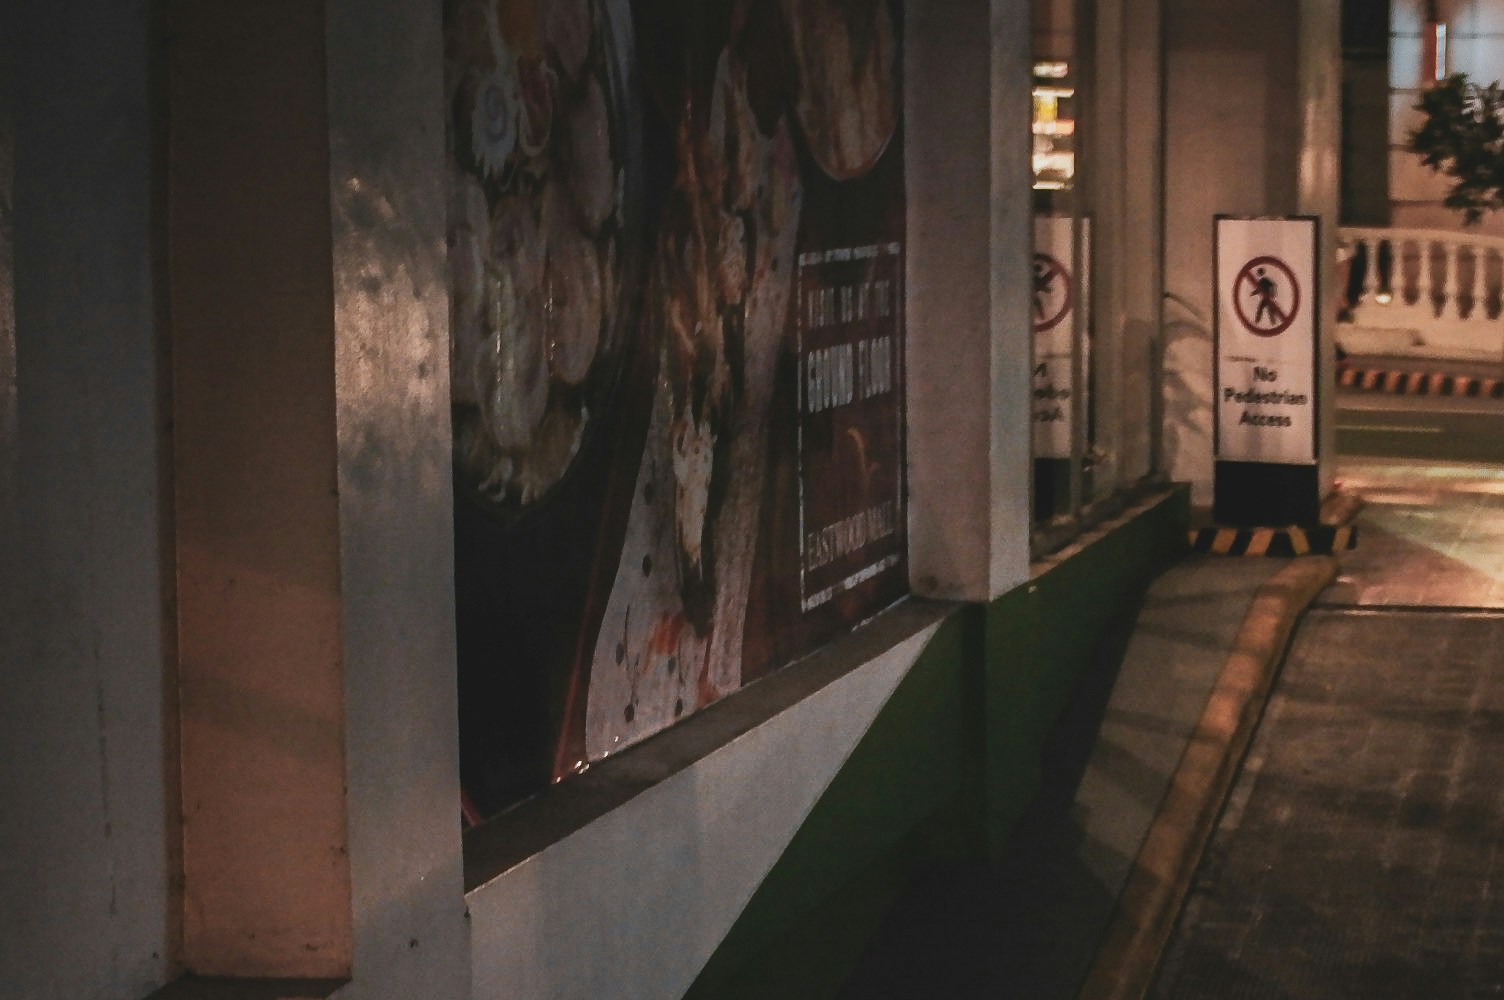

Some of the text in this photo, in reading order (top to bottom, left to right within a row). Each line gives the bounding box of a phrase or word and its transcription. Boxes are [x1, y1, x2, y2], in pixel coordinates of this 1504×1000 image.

[807, 337, 892, 413] GROUND FLOOR
[1253, 366, 1278, 382] No
[1224, 387, 1308, 405] Pedestrian
[1239, 410, 1292, 427] Access
[808, 510, 866, 571] EASTWOOD
